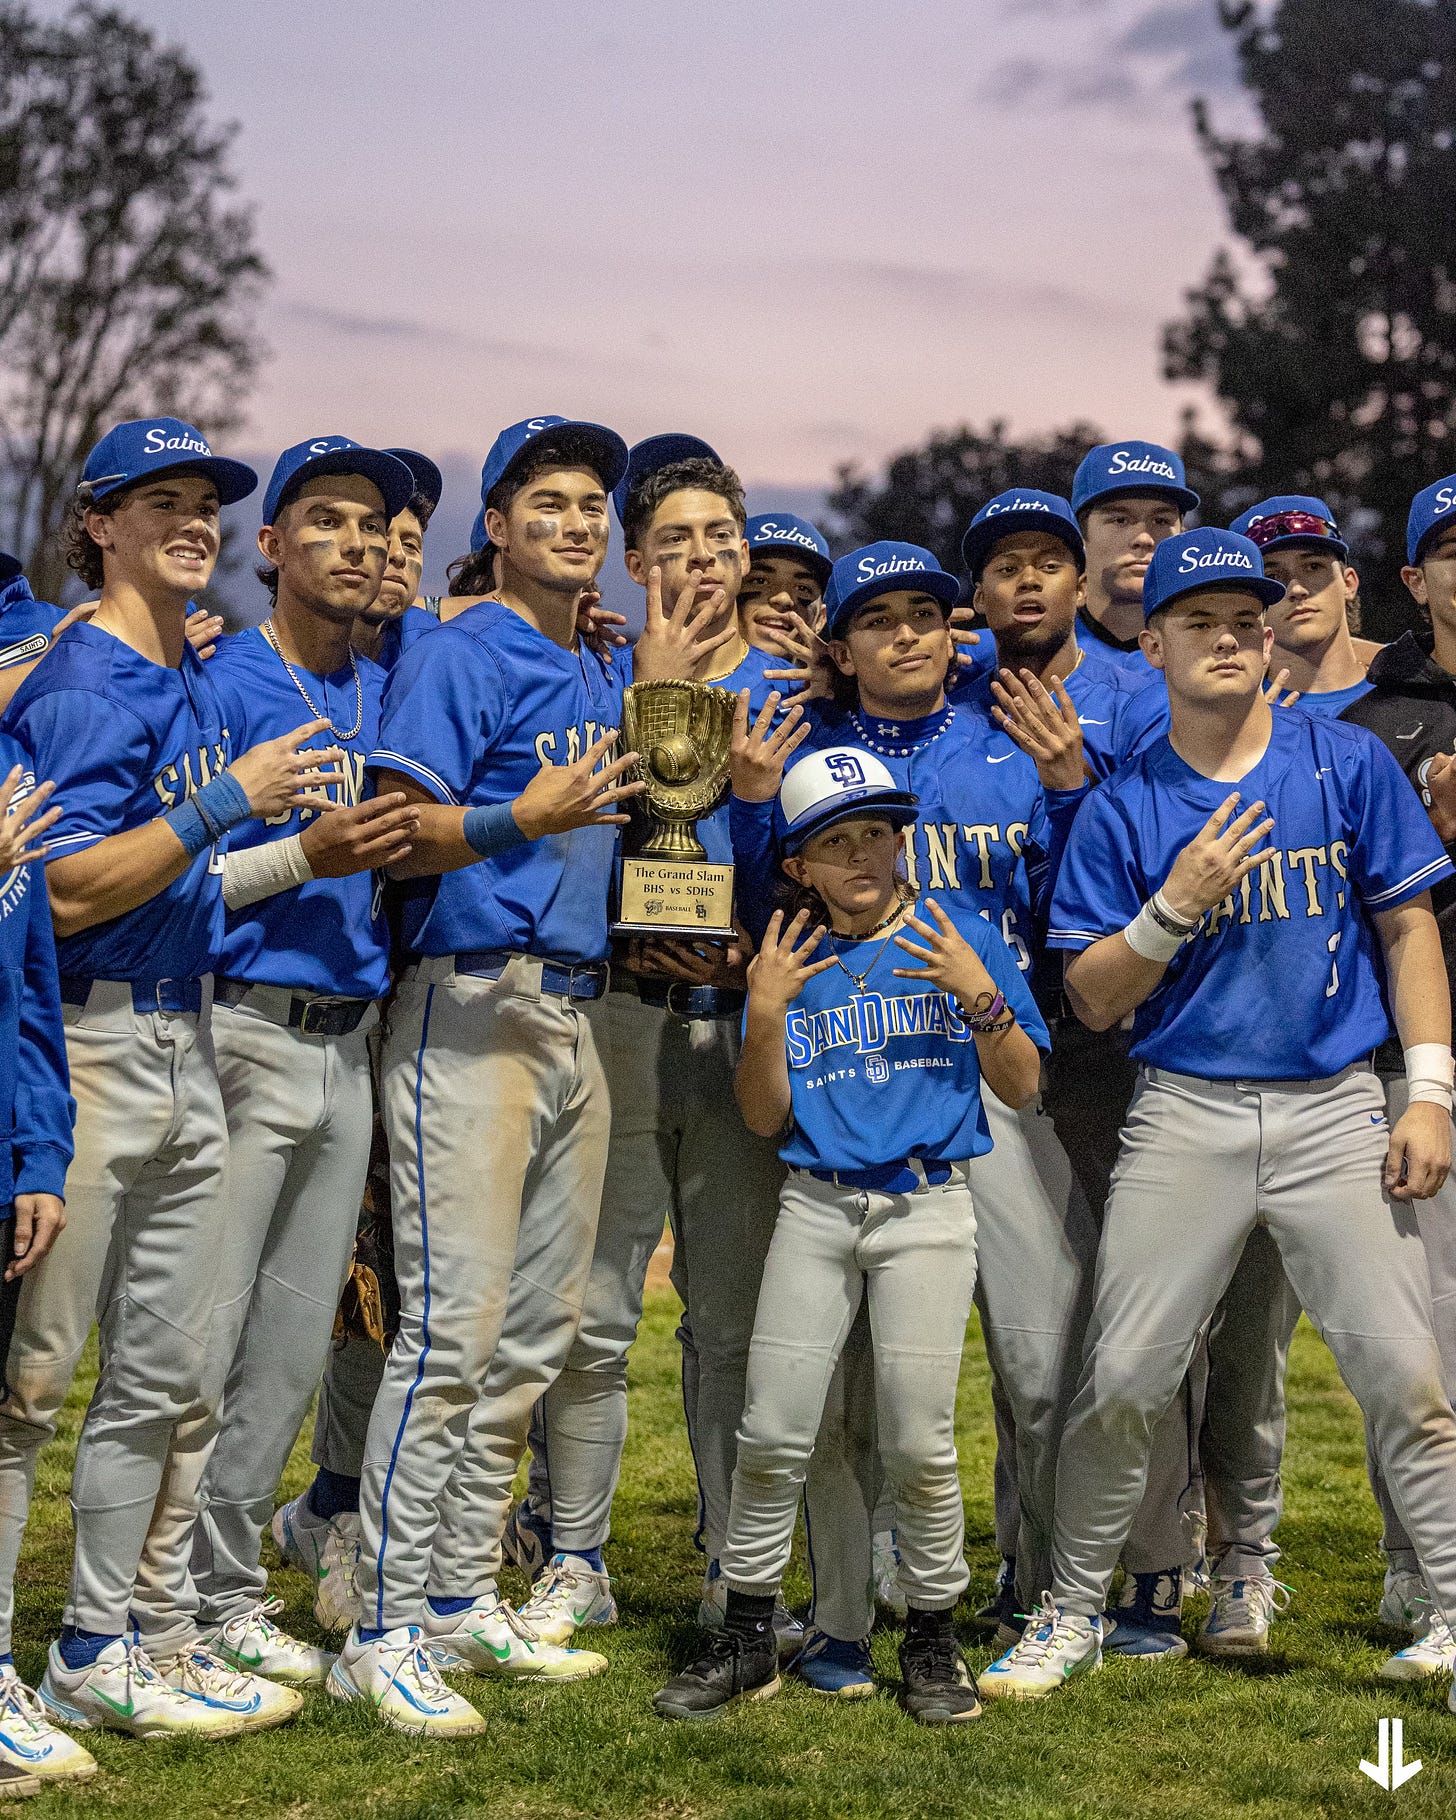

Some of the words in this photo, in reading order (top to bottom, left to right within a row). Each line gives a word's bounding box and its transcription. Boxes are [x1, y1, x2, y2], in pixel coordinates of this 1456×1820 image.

[144, 428, 212, 457] Saints
[1108, 451, 1176, 480] Saints
[753, 522, 819, 553] Saints
[856, 554, 926, 583] Saints
[1178, 545, 1253, 574] Saints
[20, 639, 44, 654] SAINTS
[825, 753, 866, 788] SD
[635, 866, 655, 878] The
[658, 868, 694, 881] Grand
[696, 870, 724, 882] Slam
[0, 865, 32, 923] AINT
[643, 883, 665, 894] BHS
[670, 886, 681, 895] vs
[686, 885, 715, 897] SDHS
[1186, 840, 1349, 944] AINTS
[665, 905, 692, 913] BASEBALL
[785, 1008, 860, 1069] SAN
[849, 991, 974, 1055] DIMAS
[806, 1068, 857, 1090] SAINTS
[894, 1057, 954, 1071] BASEBALL
